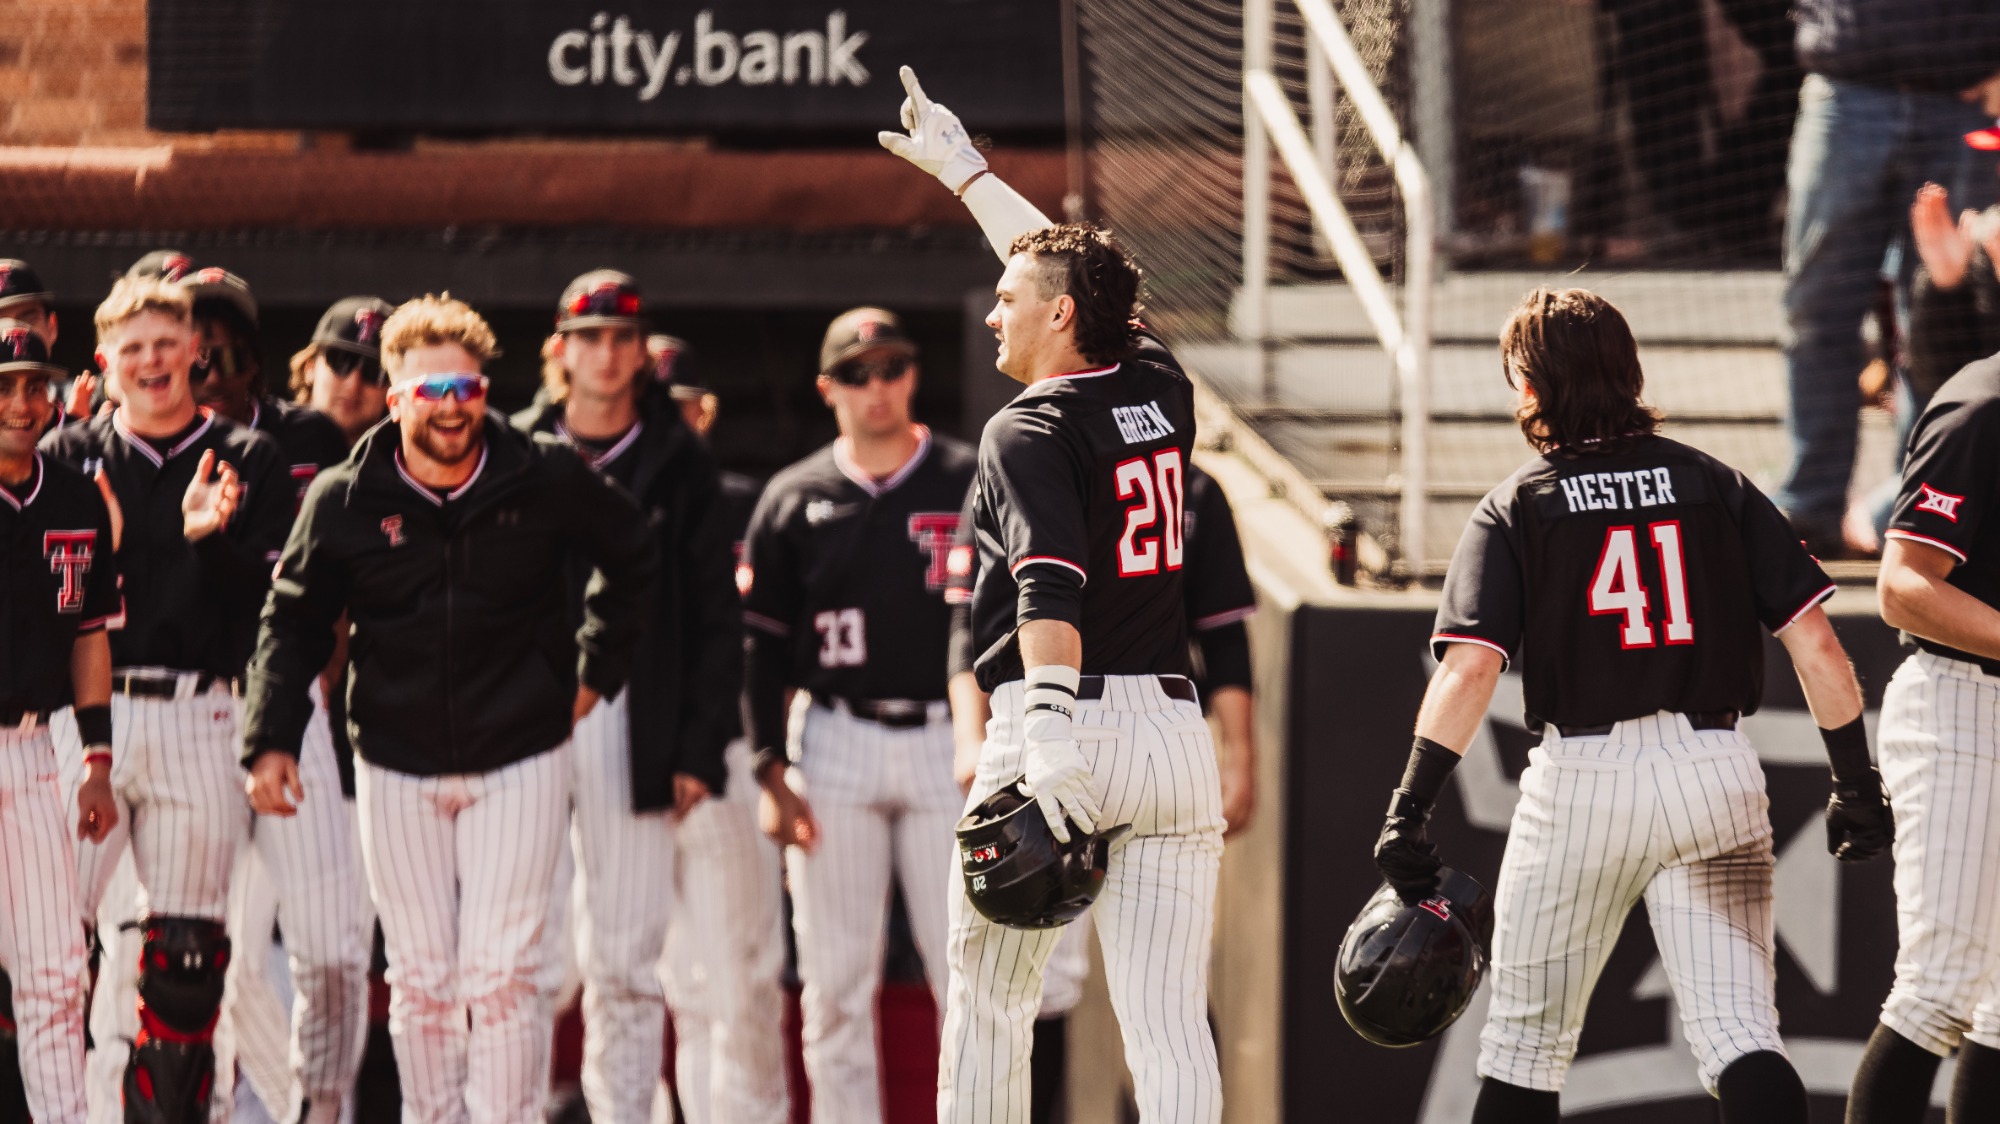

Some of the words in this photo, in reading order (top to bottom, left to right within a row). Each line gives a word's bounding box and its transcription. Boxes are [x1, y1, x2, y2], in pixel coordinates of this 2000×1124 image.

[548, 9, 871, 101] city.bank
[1112, 401, 1175, 444] GREEN
[1114, 447, 1184, 578] 20
[1560, 467, 1677, 512] HESTER
[1914, 482, 1966, 524] XII
[1587, 520, 1694, 650] 41
[814, 607, 867, 669] 33
[972, 875, 987, 891] 20
